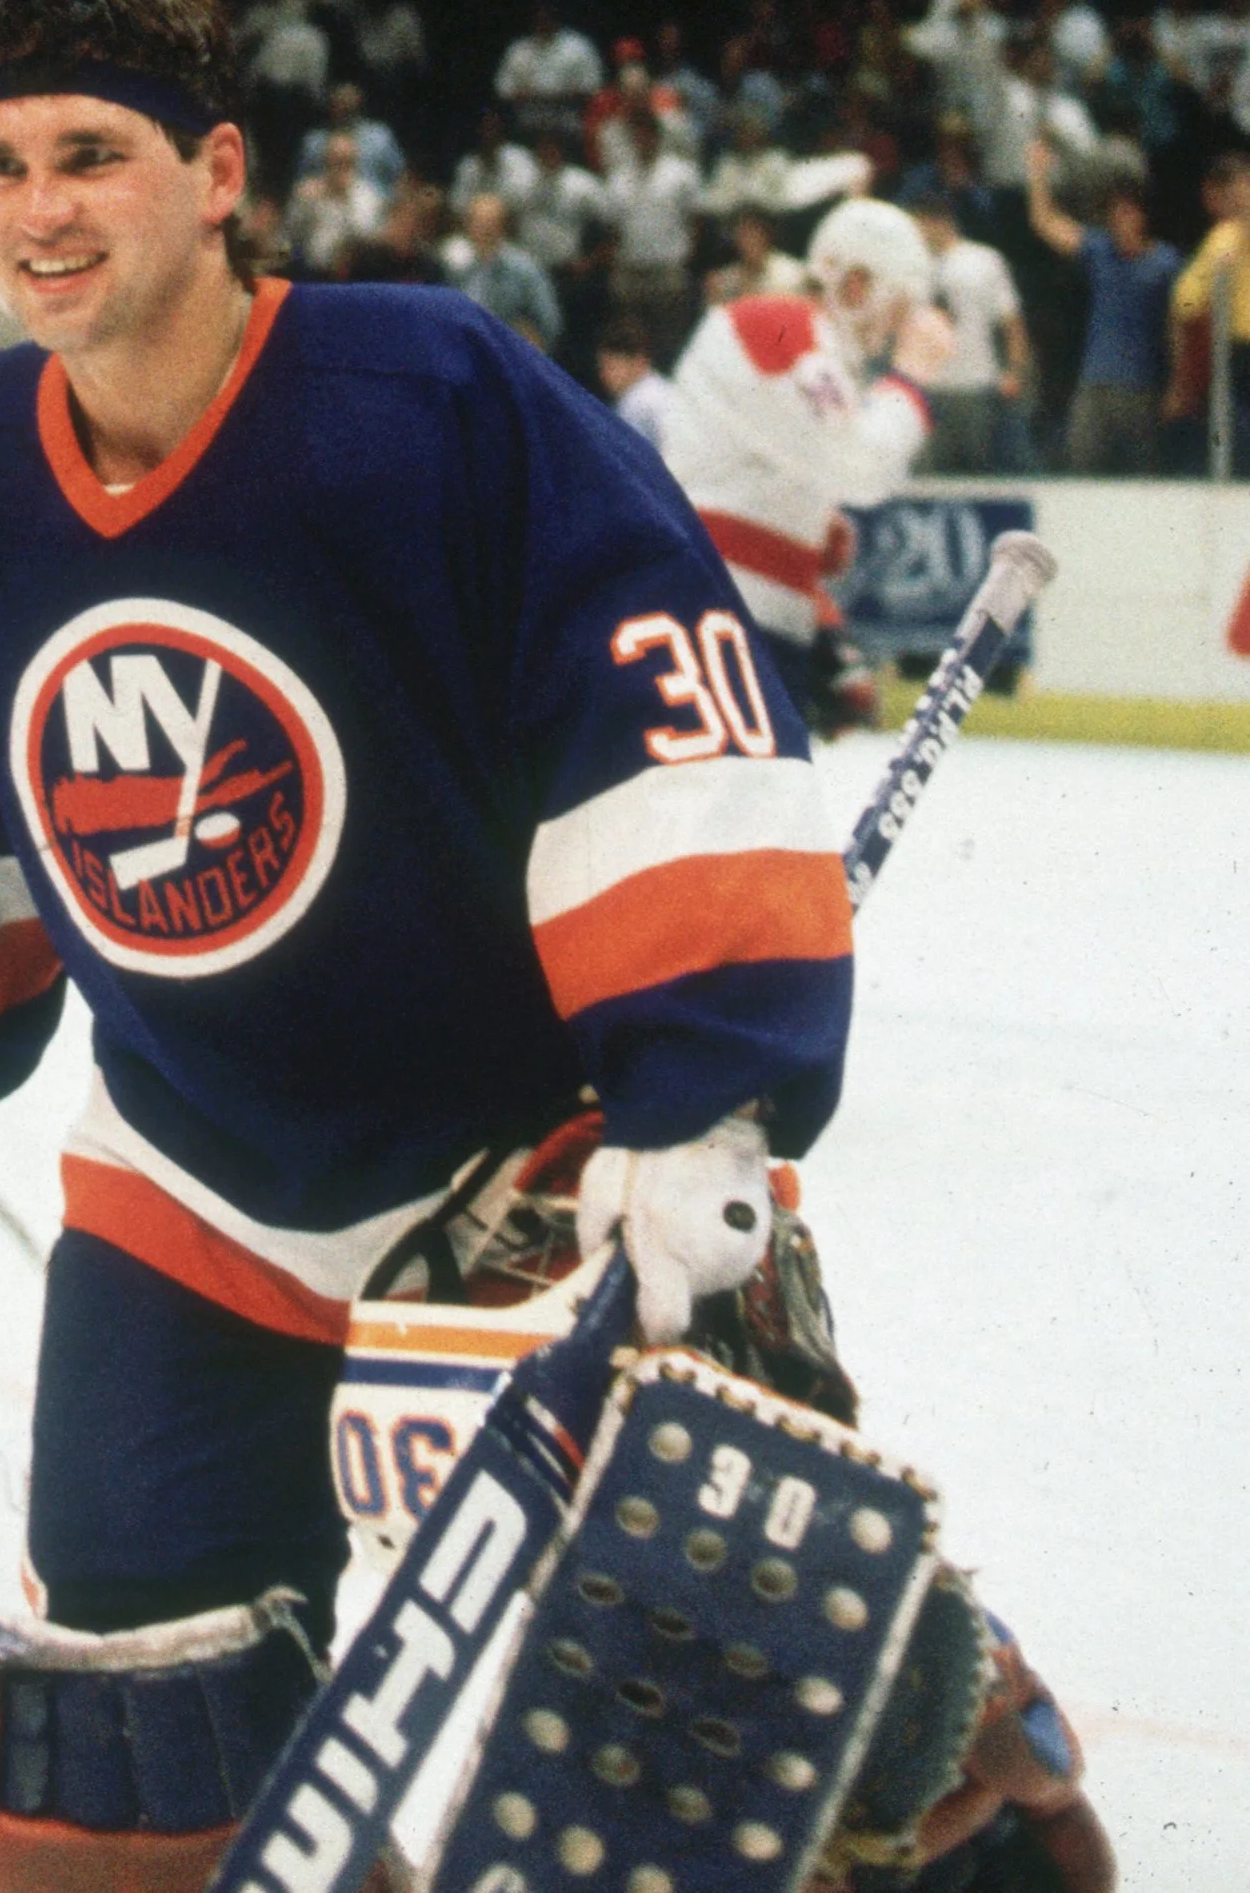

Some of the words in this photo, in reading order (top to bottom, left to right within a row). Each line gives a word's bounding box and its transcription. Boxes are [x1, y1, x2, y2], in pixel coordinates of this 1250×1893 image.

[62, 653, 222, 775] NY
[610, 609, 777, 765] 30
[72, 791, 296, 935] ISLANDERS
[697, 1443, 817, 1549] 30
